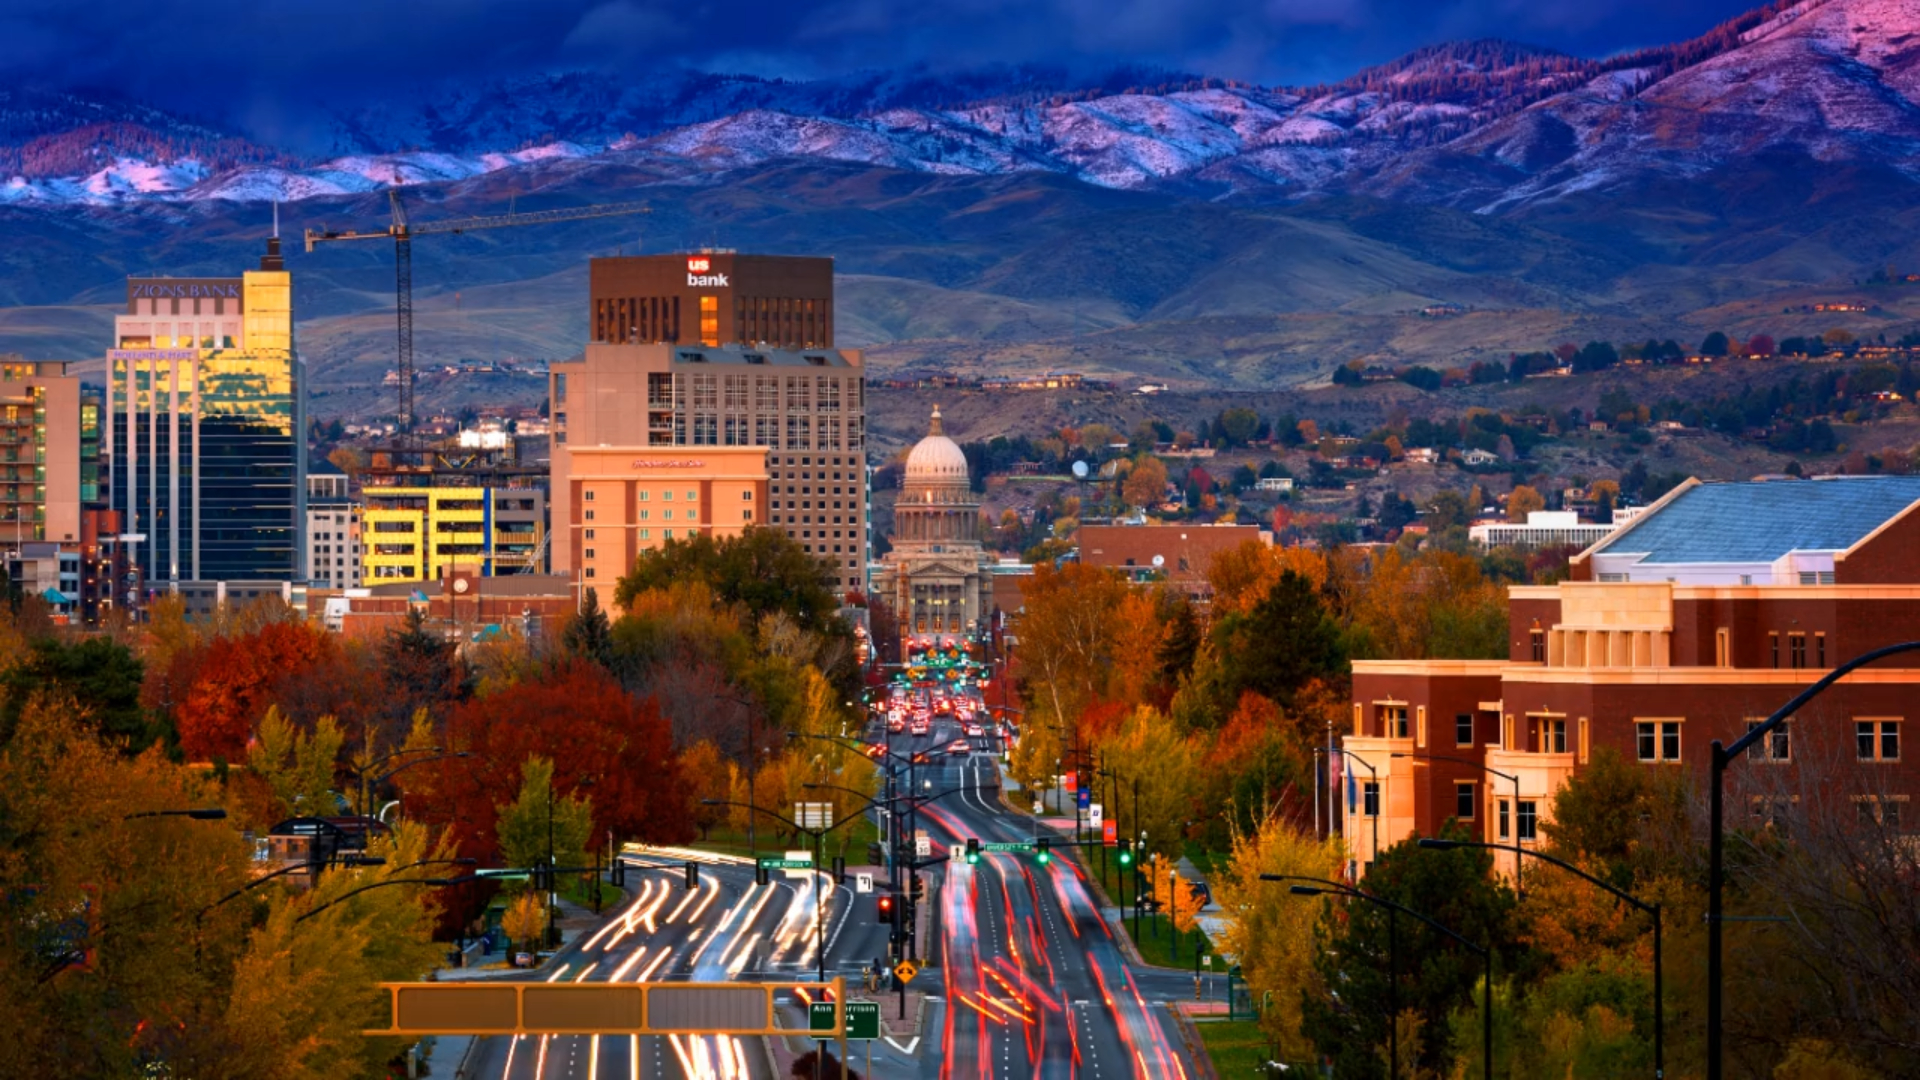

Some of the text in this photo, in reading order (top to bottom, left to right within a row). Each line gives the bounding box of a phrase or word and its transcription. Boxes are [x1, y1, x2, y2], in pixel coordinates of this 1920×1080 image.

[688, 260, 709, 271] us
[687, 273, 729, 287] bank
[132, 284, 240, 298] ZIONS BANK
